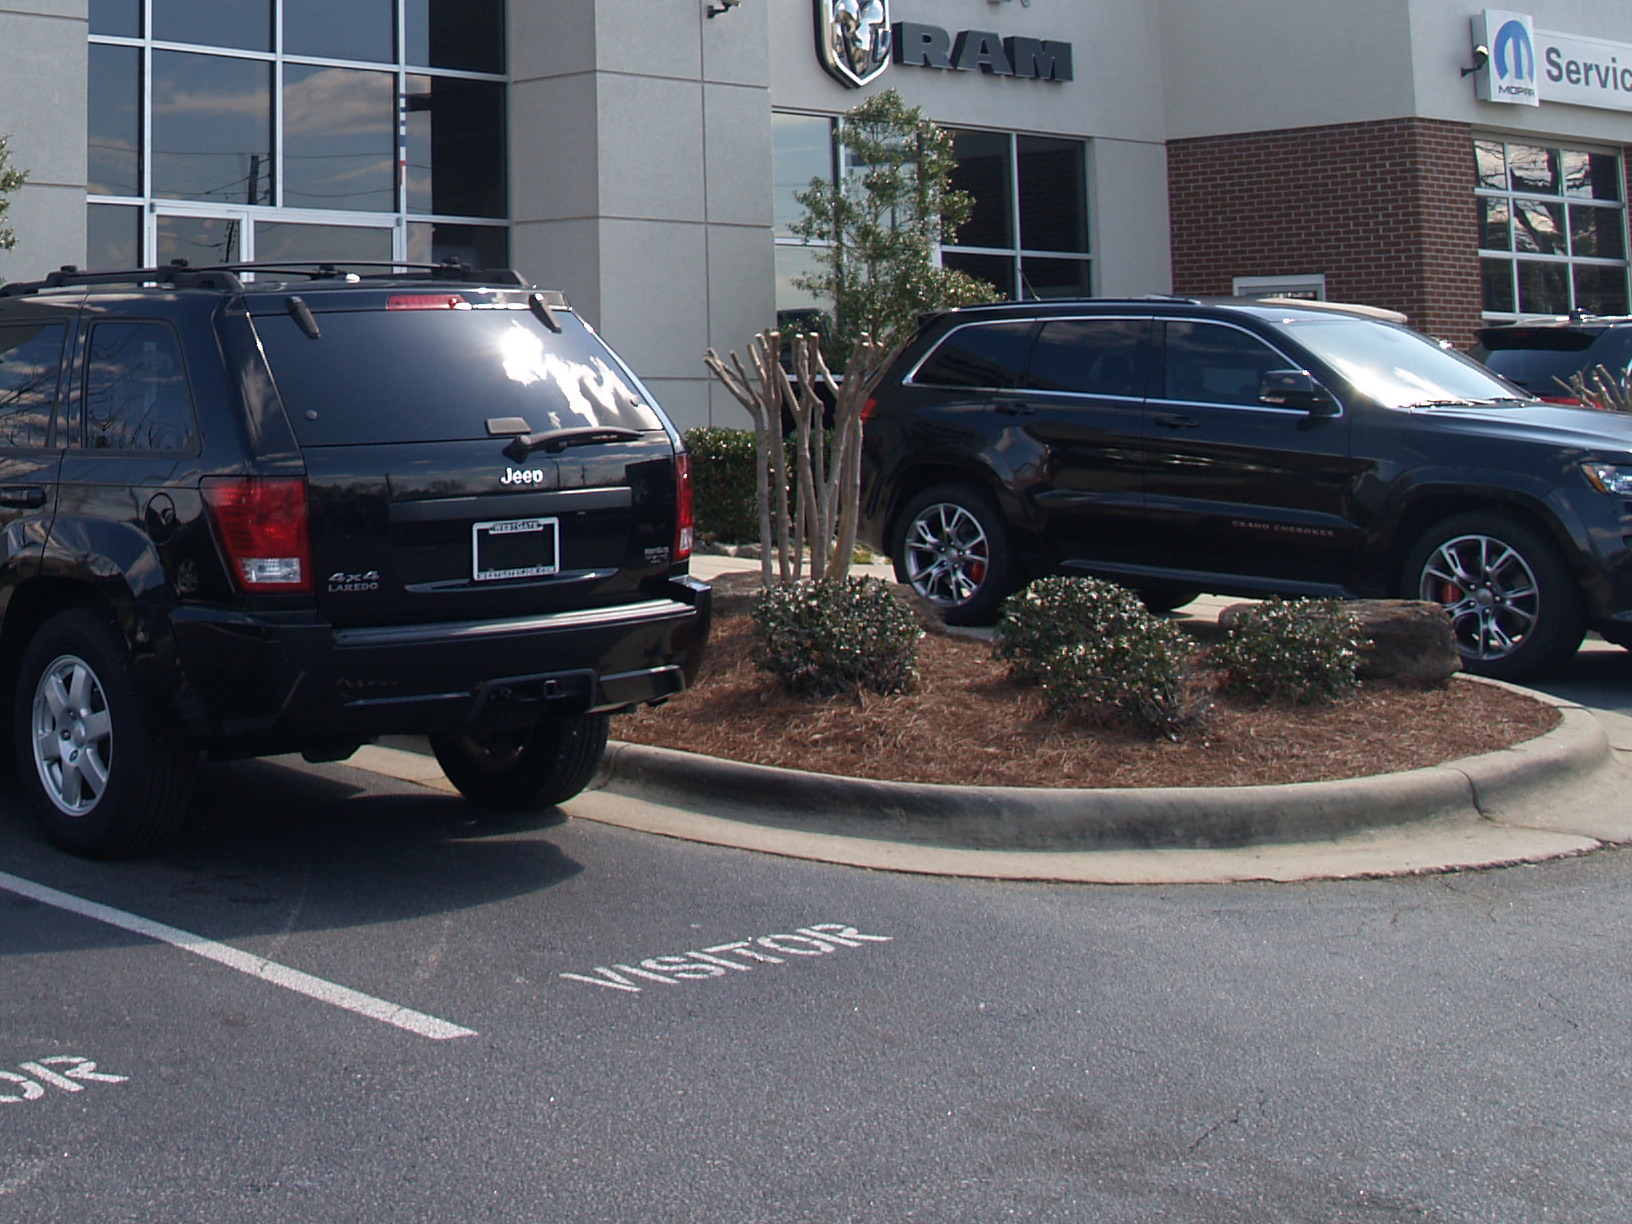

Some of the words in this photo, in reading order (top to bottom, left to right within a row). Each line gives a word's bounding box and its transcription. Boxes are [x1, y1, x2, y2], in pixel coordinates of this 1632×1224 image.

[892, 21, 1073, 82] RAM
[1498, 84, 1534, 97] MOPAR
[500, 467, 544, 487] Jeep
[1231, 520, 1270, 531] GRAND
[1274, 524, 1334, 537] CHEROKEE
[328, 582, 379, 593] LAREDO
[559, 922, 894, 993] VISITOR
